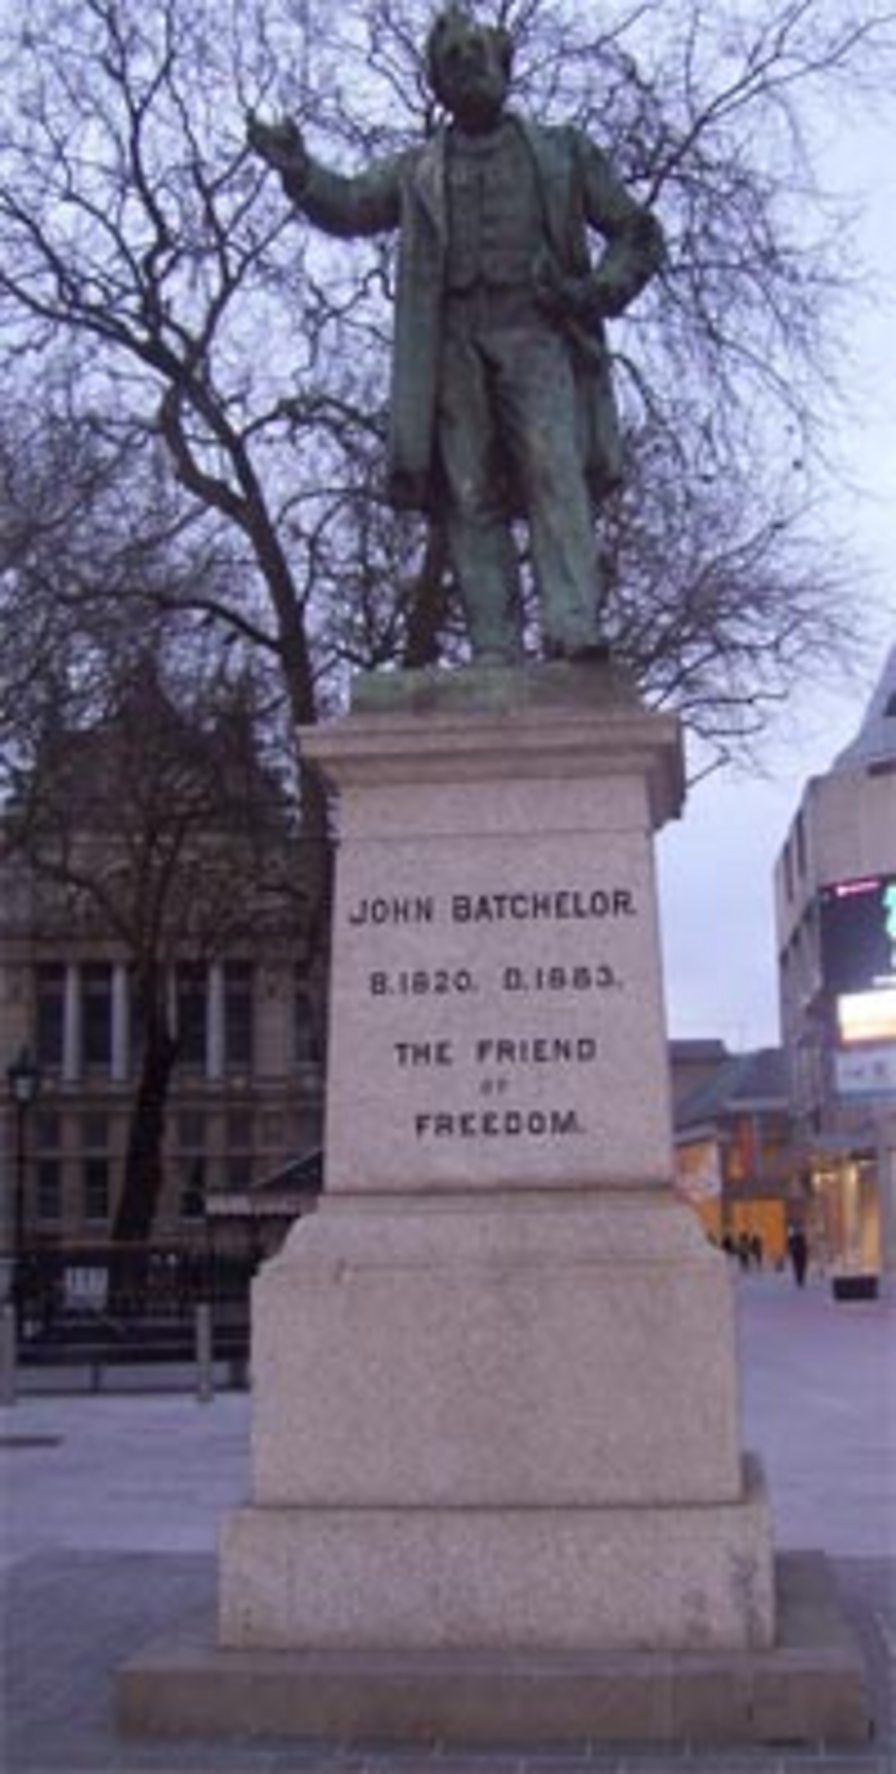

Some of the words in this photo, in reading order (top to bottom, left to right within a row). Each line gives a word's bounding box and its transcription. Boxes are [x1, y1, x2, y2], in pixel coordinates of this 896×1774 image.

[349, 896, 434, 925] JOHN
[394, 1041, 453, 1066] THE
[476, 1038, 597, 1063] FRIEND
